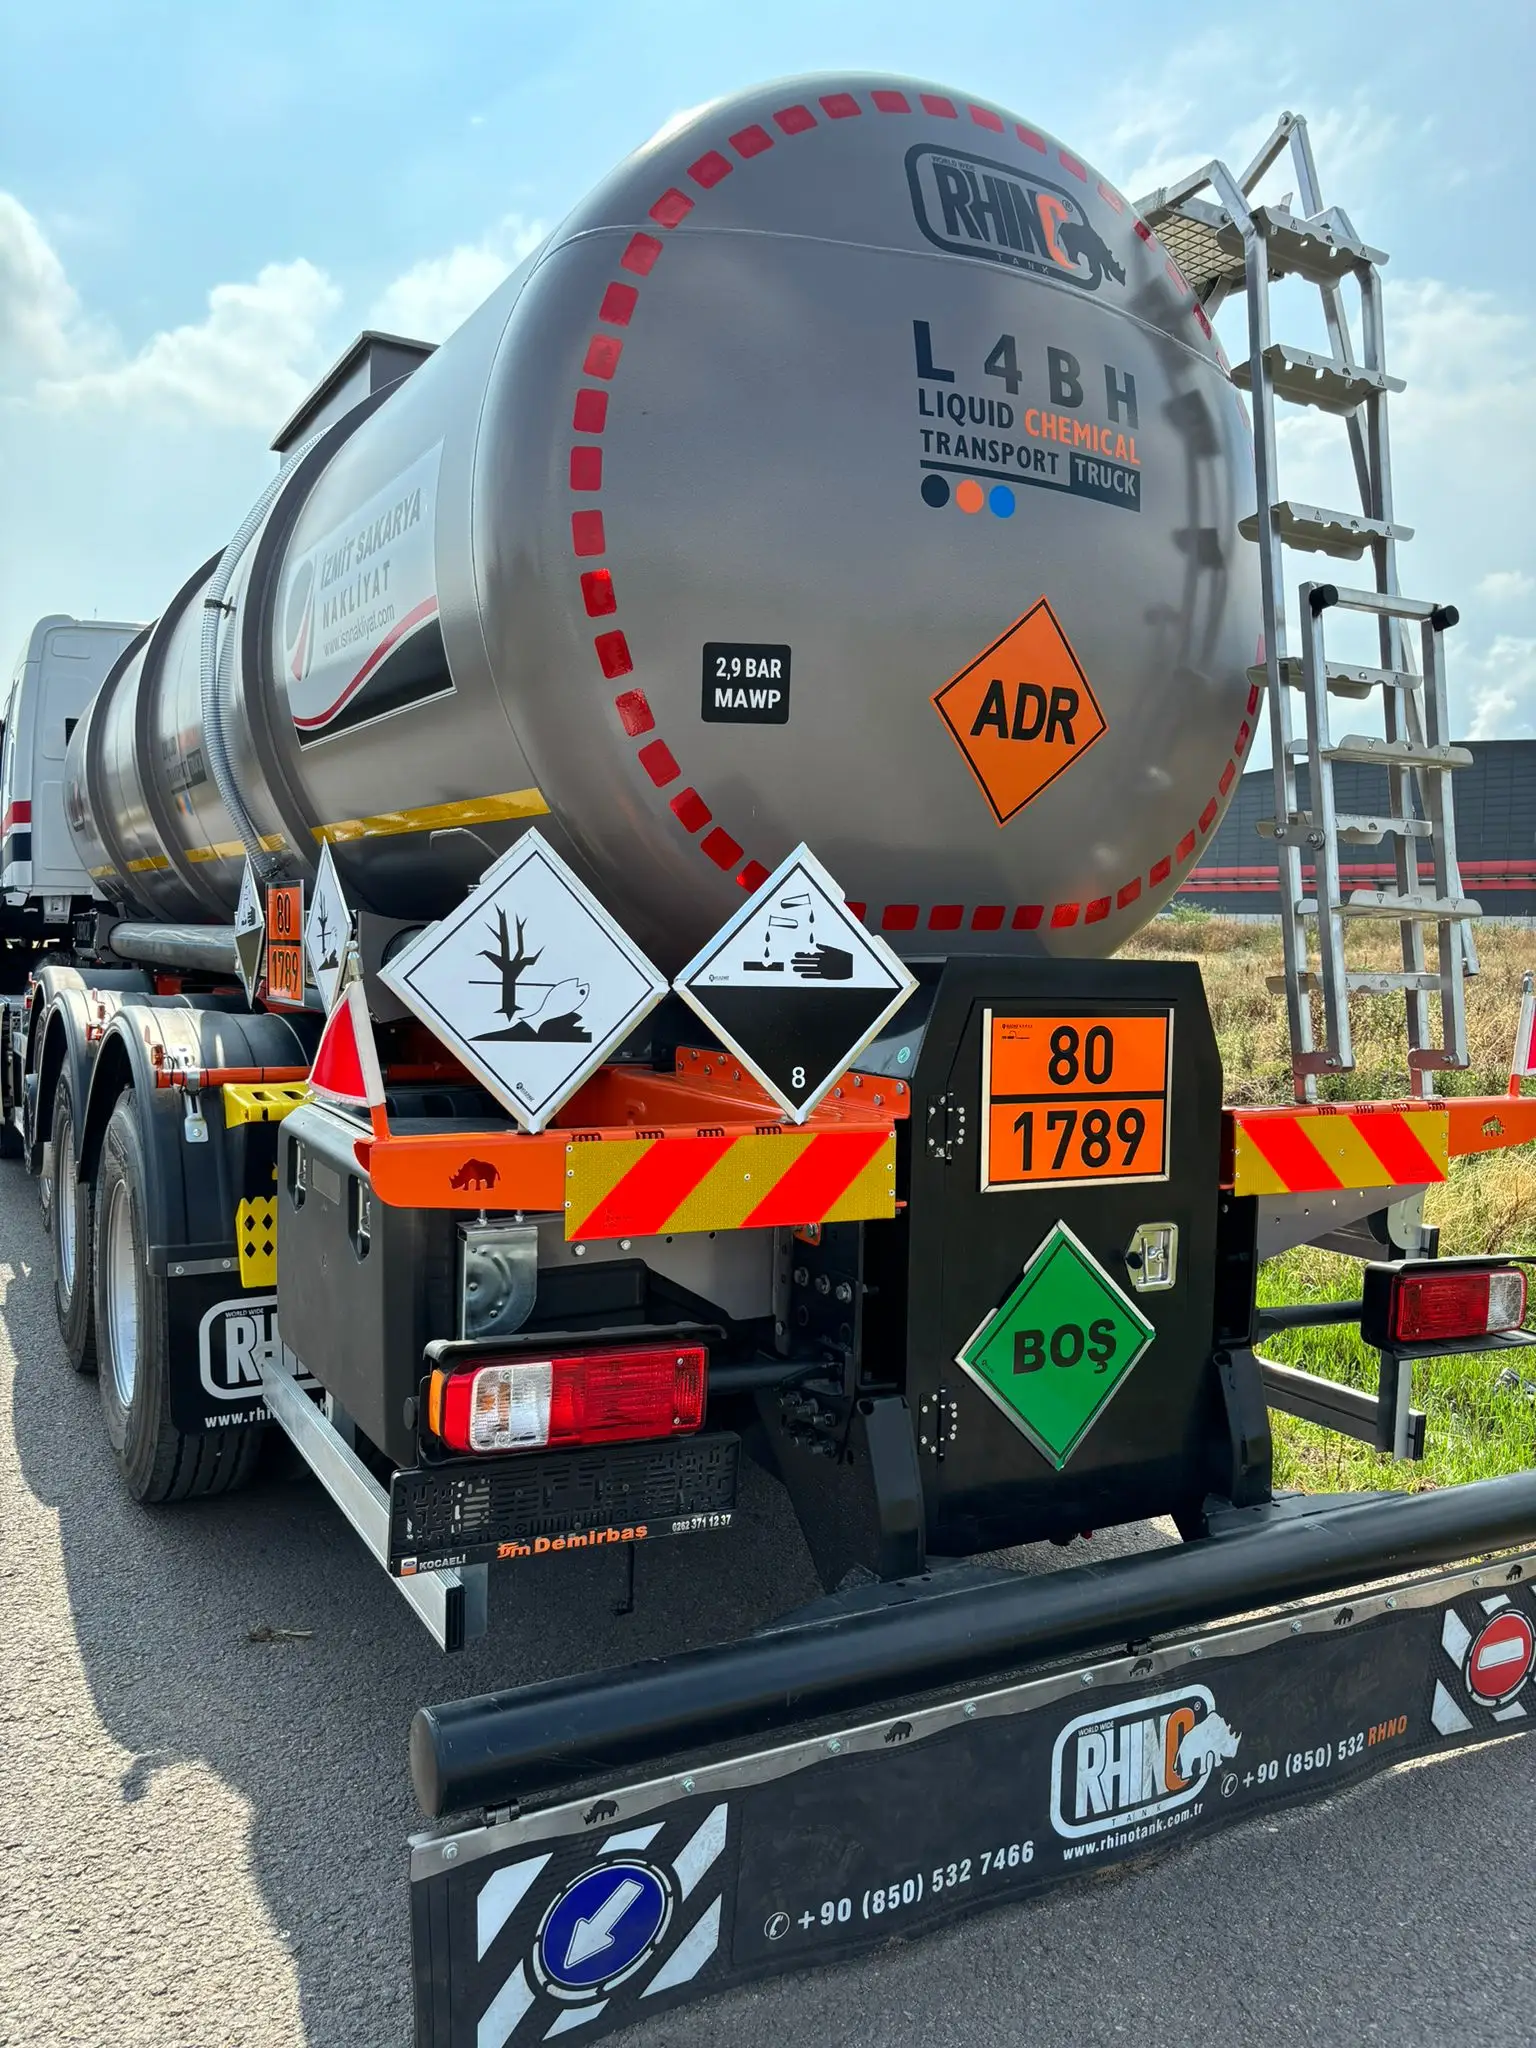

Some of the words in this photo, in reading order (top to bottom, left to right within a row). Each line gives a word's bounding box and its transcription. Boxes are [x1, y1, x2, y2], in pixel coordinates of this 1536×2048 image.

[918, 388, 1014, 429] LIQUID
[1024, 408, 1141, 466] CHEMICAL
[920, 429, 1059, 476] TRANSPORT
[1074, 457, 1137, 497] TRUCK
[356, 487, 421, 565] SAKARYA
[322, 559, 391, 630] NAKLİYAT
[715, 657, 742, 680] 2,9
[745, 659, 782, 680] BAR
[714, 688, 781, 710] MAWP
[969, 679, 1080, 746] ADR
[276, 892, 291, 934] 80
[271, 949, 299, 993] 1789
[791, 1066, 806, 1089] 8
[1048, 1025, 1114, 1086] 80
[1013, 1107, 1146, 1172] 1789
[225, 1309, 247, 1318] WORLD
[248, 1307, 264, 1315] WIDE
[1012, 1319, 1117, 1376] BOŞ
[534, 1524, 648, 1554] Demirbaş
[690, 1516, 707, 1529] 371
[709, 1515, 719, 1527] 12
[721, 1513, 732, 1525] 37
[1078, 1725, 1099, 1737] WORLD
[1099, 1720, 1115, 1730] WIDE
[1285, 1743, 1332, 1777] (850)
[1338, 1732, 1364, 1761] 532
[1367, 1714, 1408, 1747] RHNO
[1063, 1802, 1203, 1861] www.rhinotank.com.tr
[862, 1873, 924, 1919] (850)
[932, 1858, 972, 1892] 532
[980, 1840, 1035, 1875] 7466
